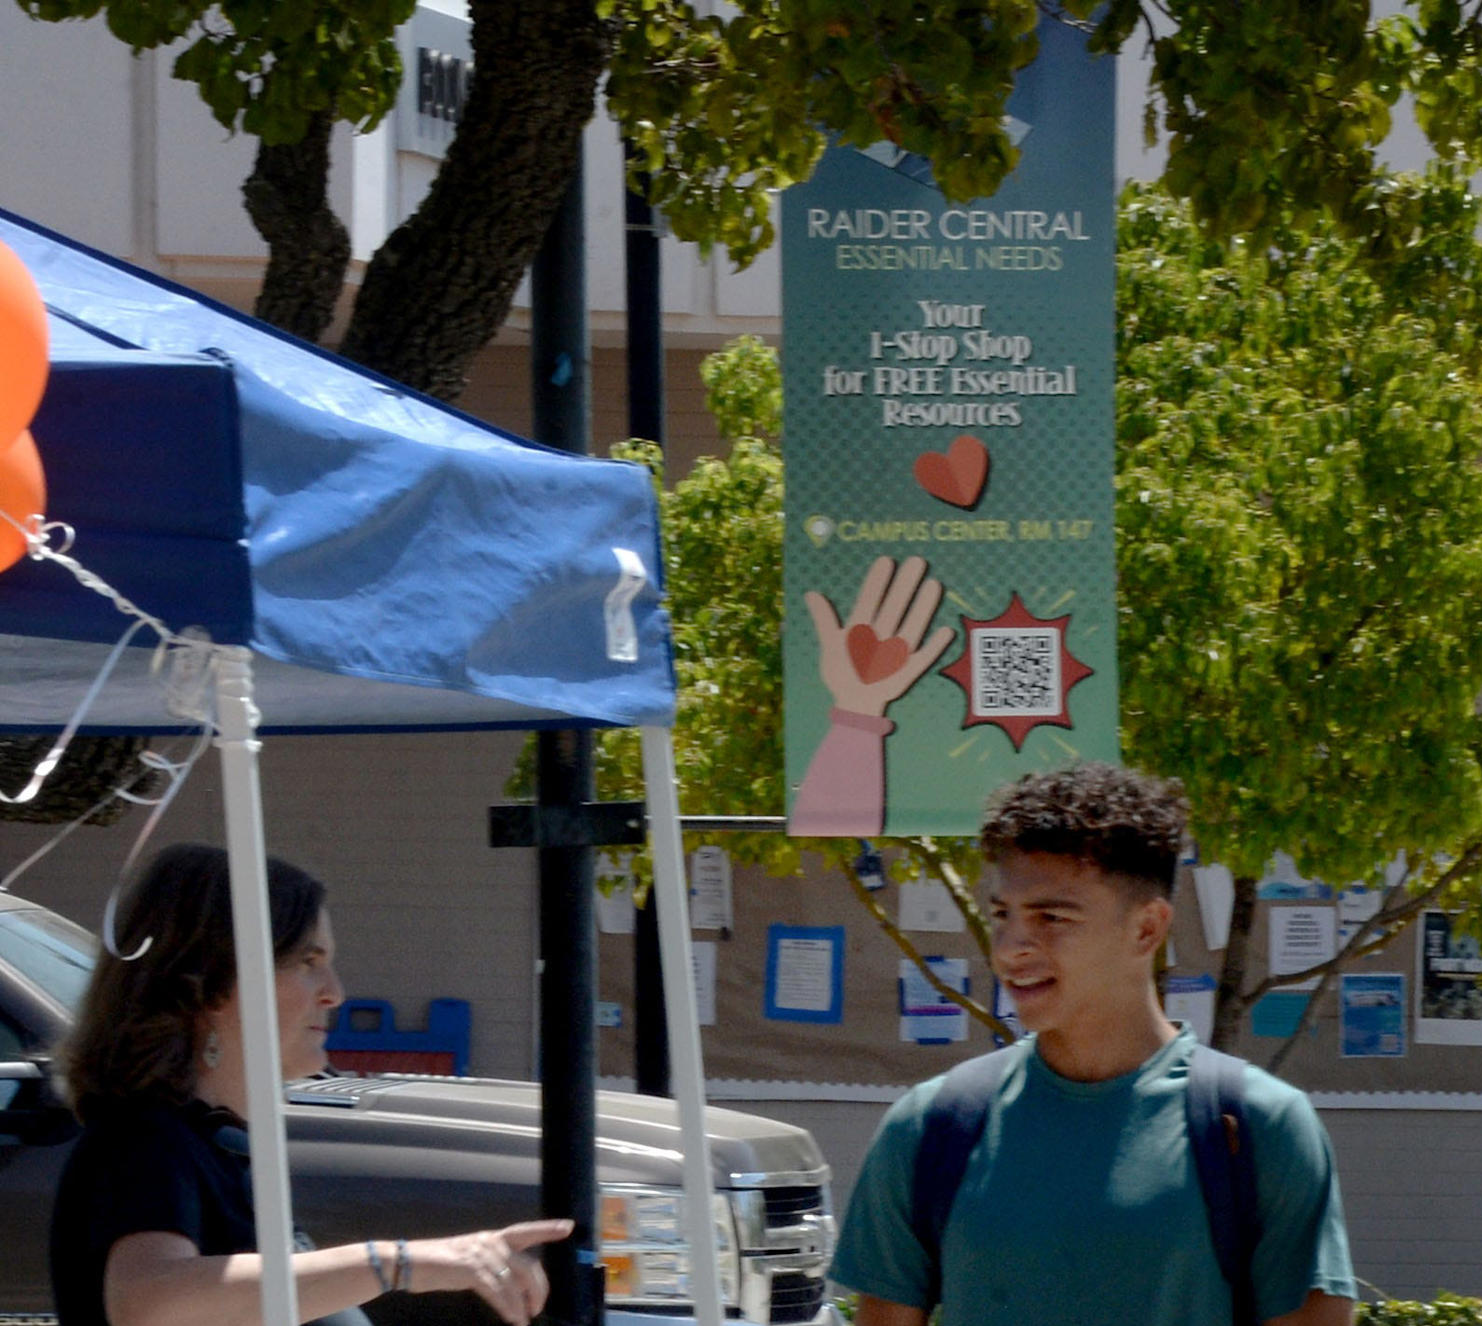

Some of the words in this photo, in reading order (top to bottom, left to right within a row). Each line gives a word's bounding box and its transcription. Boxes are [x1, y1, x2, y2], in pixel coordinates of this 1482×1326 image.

[808, 210, 931, 239] RAIDER
[939, 210, 1090, 240] CENTRAL
[836, 245, 970, 271] ESSENTIAL
[977, 246, 1063, 271] NEEDS
[918, 301, 985, 328] Your
[871, 331, 957, 364] 1-Stop
[964, 332, 1032, 364] Shop
[823, 366, 867, 396] for
[873, 368, 943, 395] FREE
[951, 366, 1076, 396] Essential
[883, 401, 1022, 426] Resources
[838, 521, 930, 541] CAMPUS
[1058, 521, 1093, 540] 147
